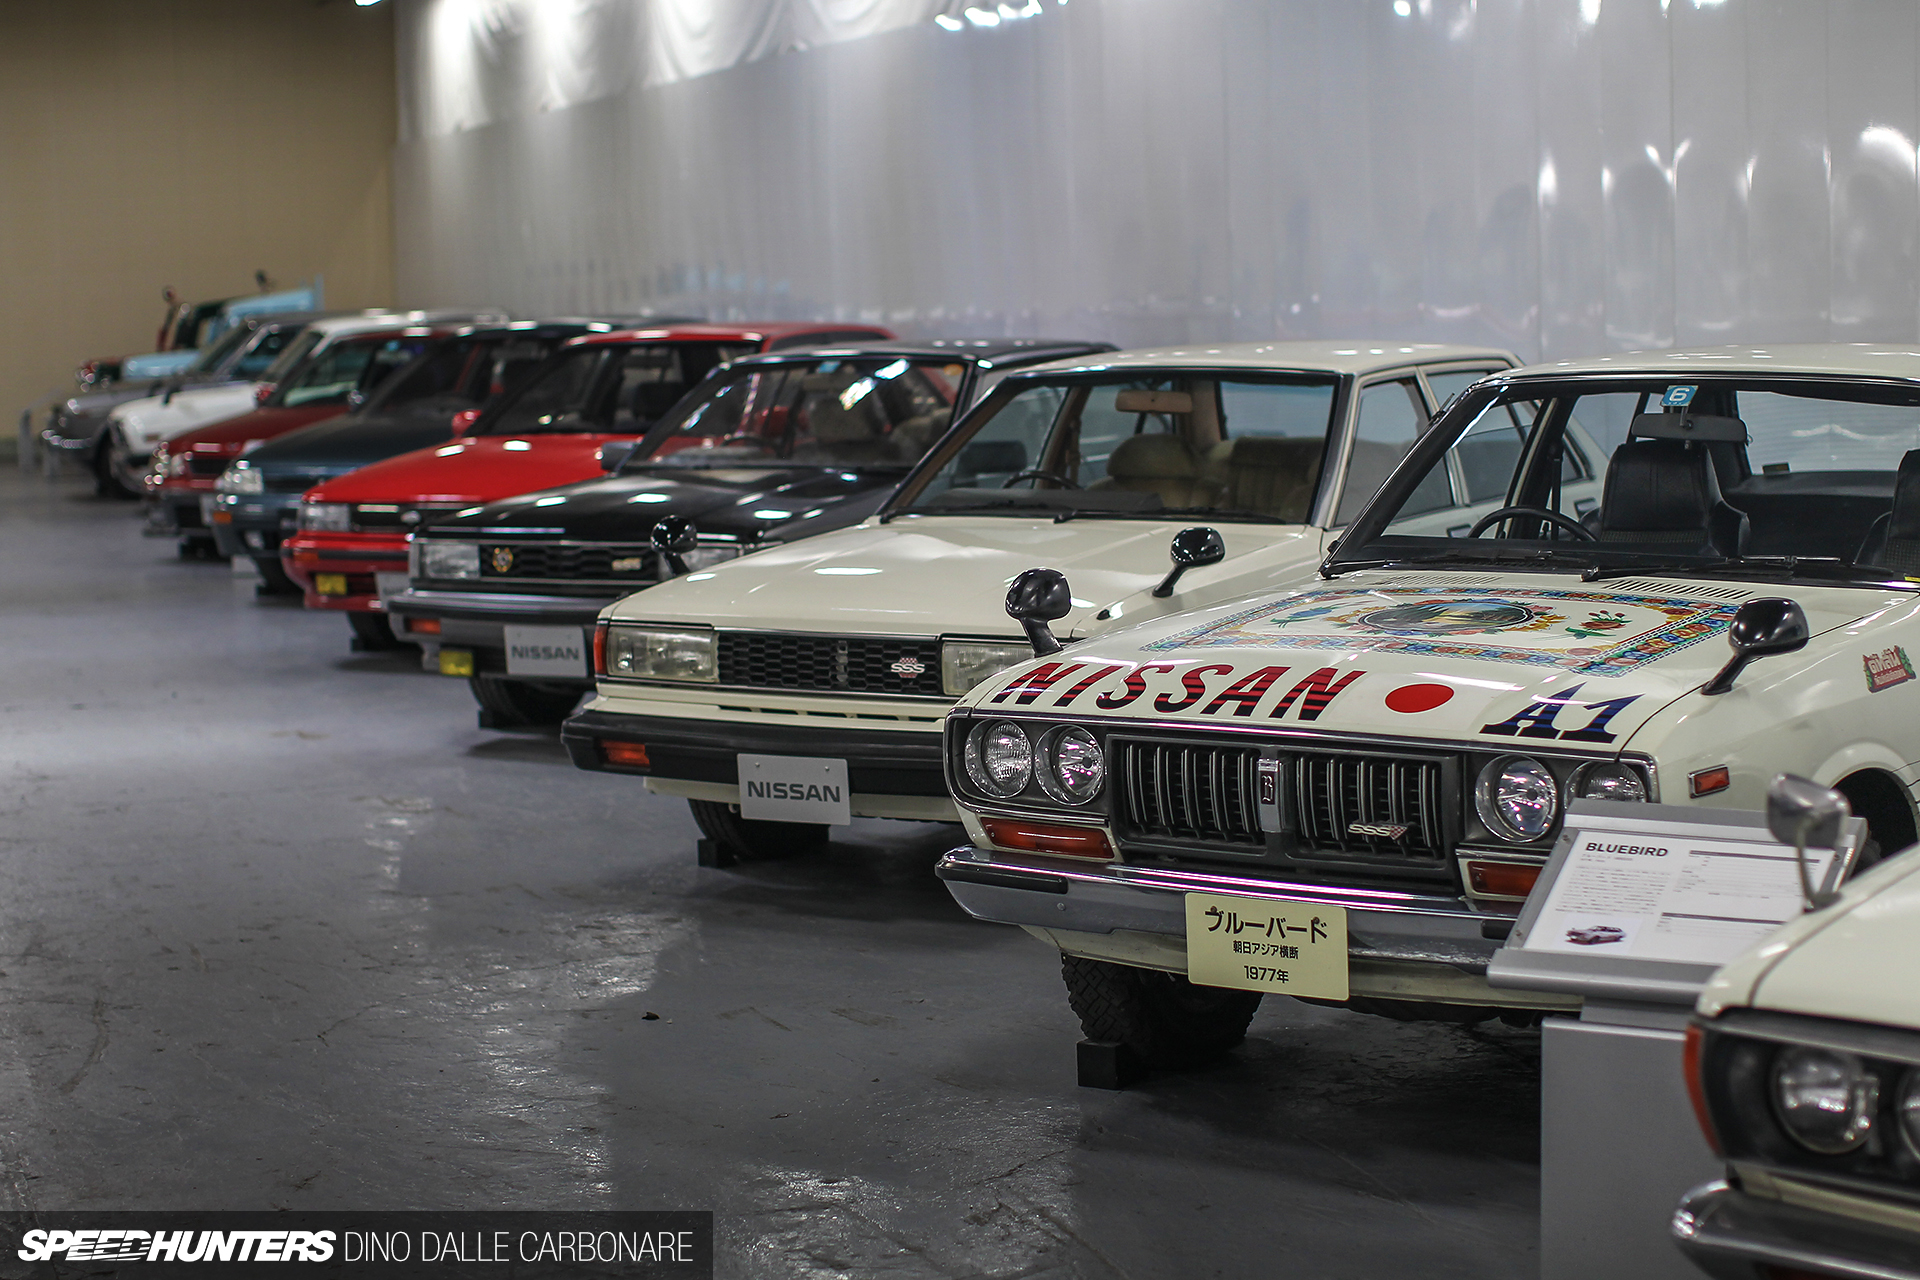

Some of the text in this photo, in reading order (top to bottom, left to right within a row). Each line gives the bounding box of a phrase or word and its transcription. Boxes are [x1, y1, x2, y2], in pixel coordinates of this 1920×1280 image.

[1669, 387, 1690, 401] 6
[511, 645, 579, 660] NISSAN
[891, 662, 925, 674] SSS
[990, 662, 1366, 721] NISSAN
[1477, 681, 1645, 743] A1
[747, 781, 841, 803] NISSAN
[1348, 823, 1391, 837] SSS
[1585, 842, 1668, 857] BLUEBIRD
[1204, 909, 1328, 944] ブルーバード
[1233, 940, 1299, 960] 朝日アジア横断
[1243, 965, 1289, 984] 1977年
